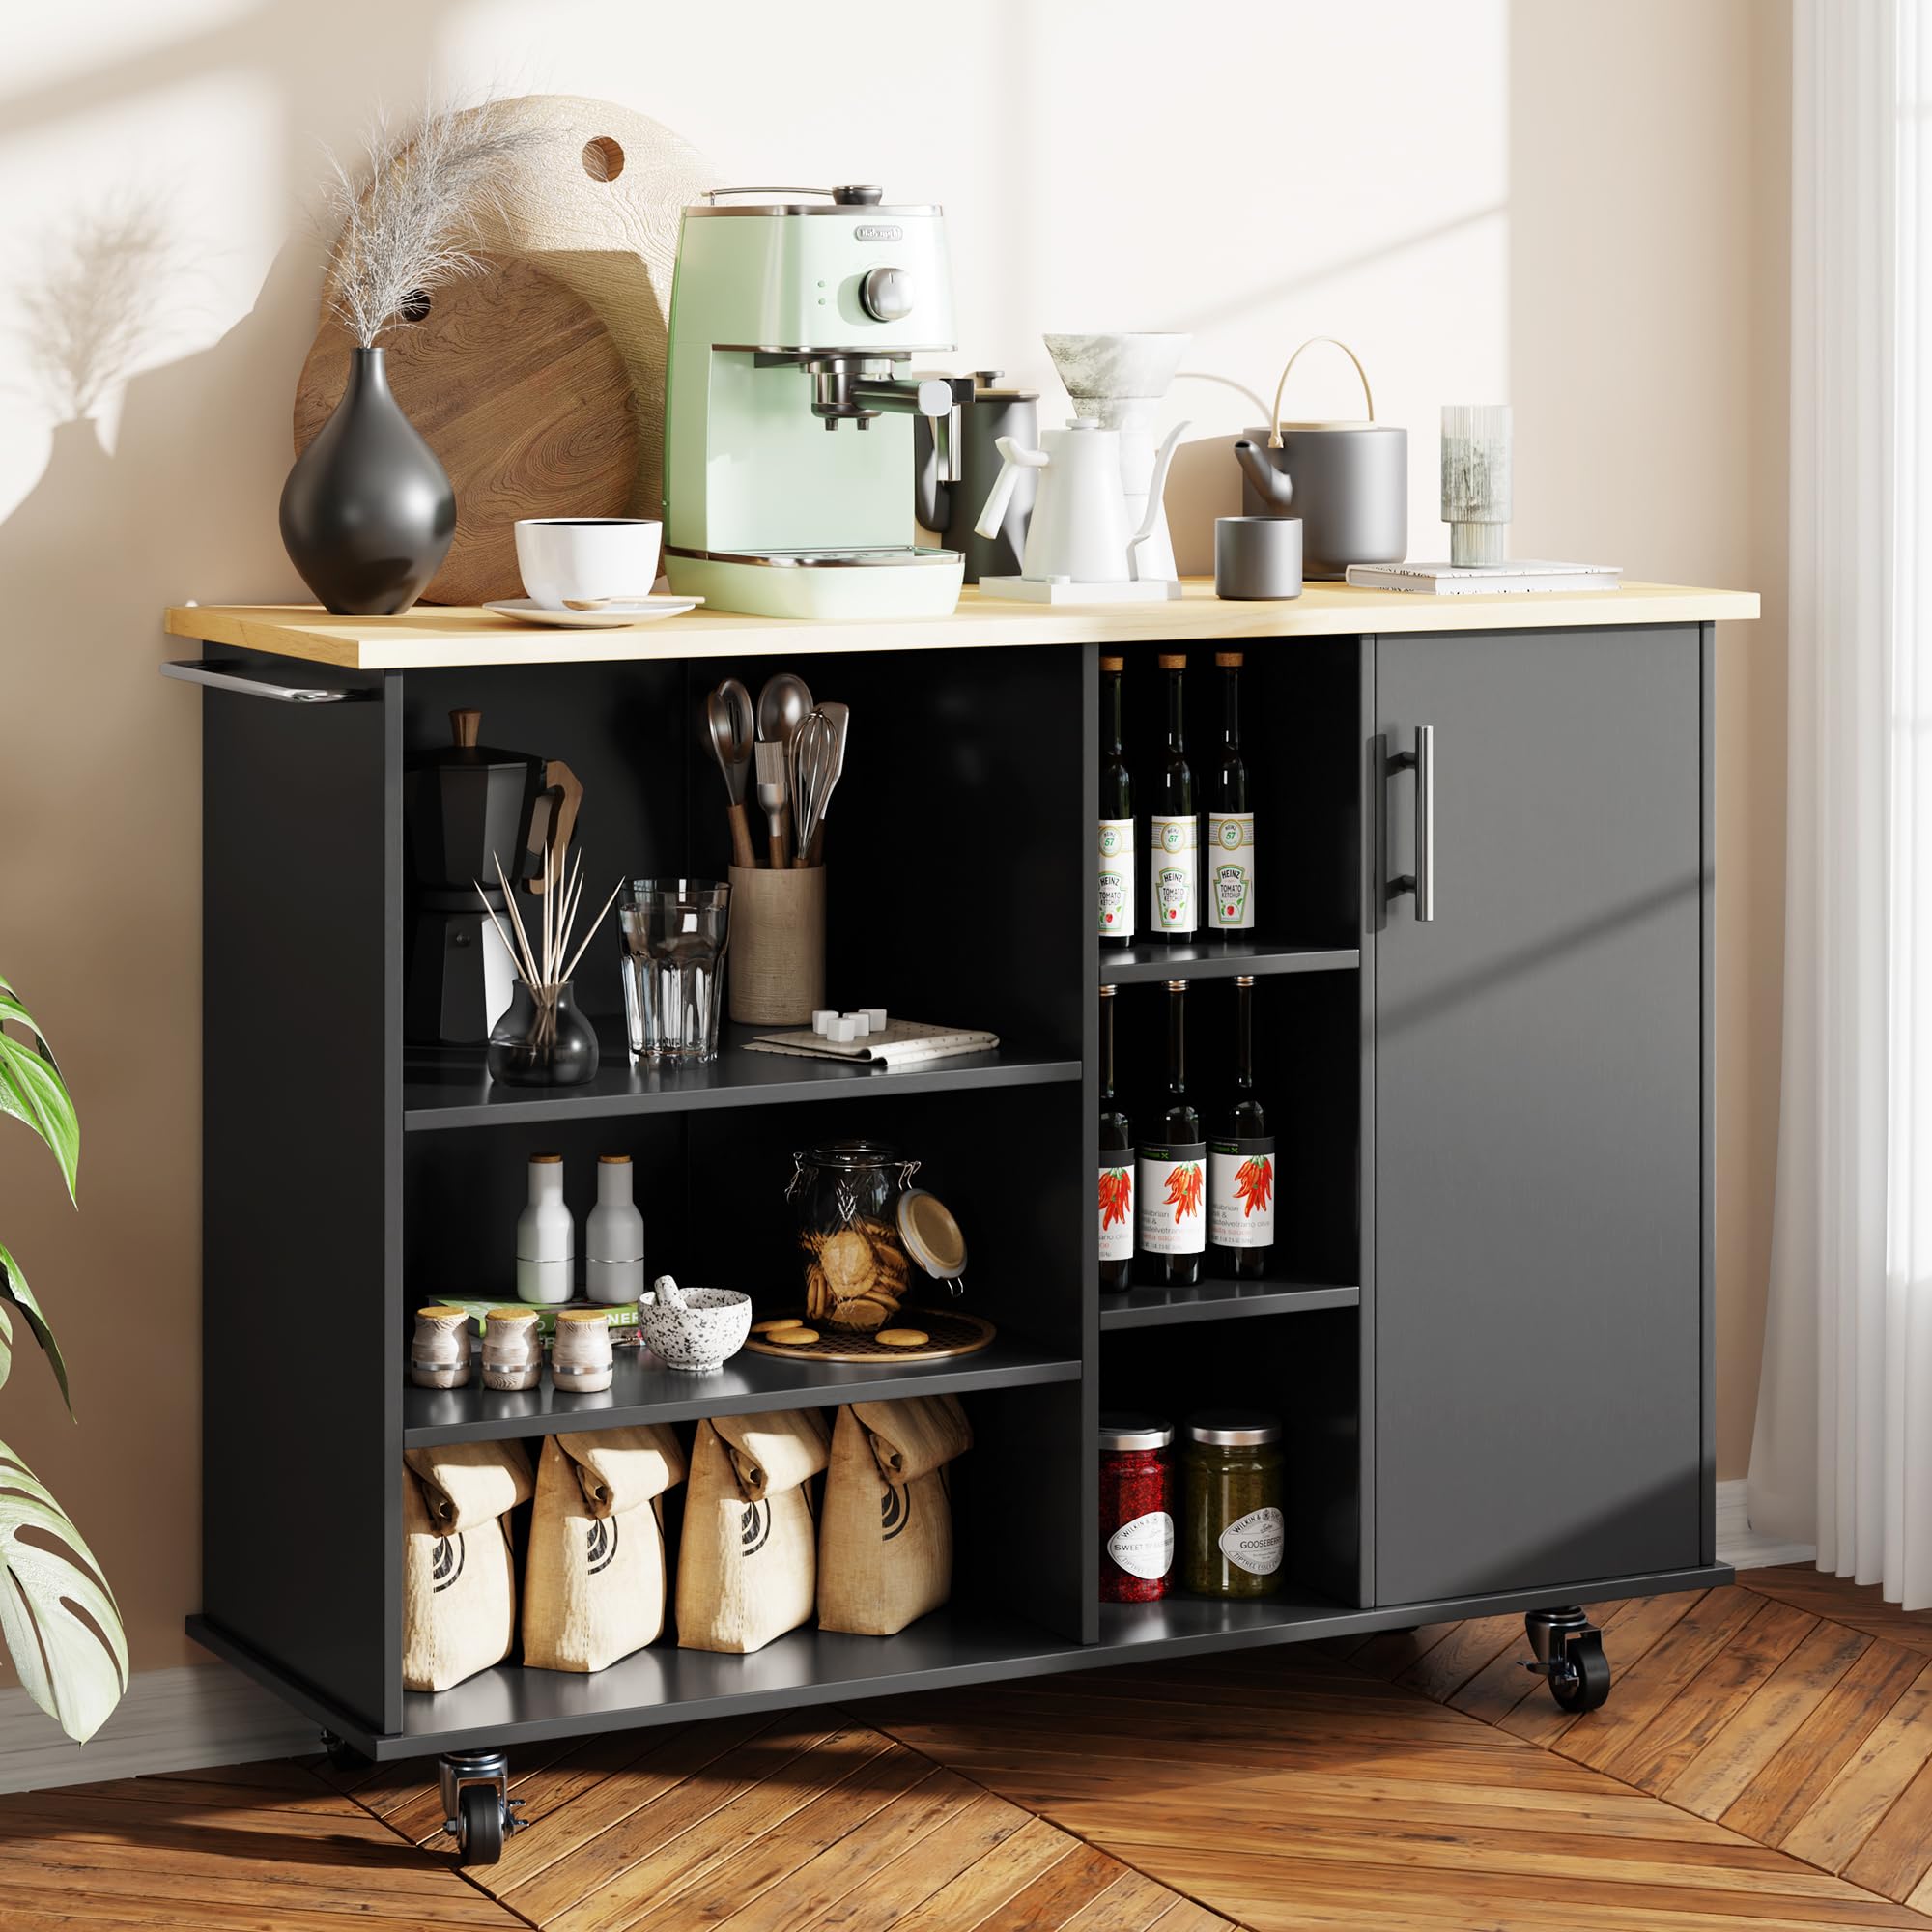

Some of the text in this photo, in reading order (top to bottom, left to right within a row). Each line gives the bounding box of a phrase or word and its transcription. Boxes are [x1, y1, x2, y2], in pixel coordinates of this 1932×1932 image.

[1168, 835, 1179, 843] 57
[1226, 832, 1236, 840] 57
[1104, 838, 1115, 847] 57
[1163, 872, 1183, 883] HEINZ
[1221, 869, 1241, 880] HEINZ
[1099, 876, 1120, 887] HEINZ
[1162, 887, 1185, 896] TOMATO
[1220, 884, 1242, 893] TOMATO
[1098, 891, 1122, 899] TOMATO
[1232, 1514, 1257, 1533] WILKIN
